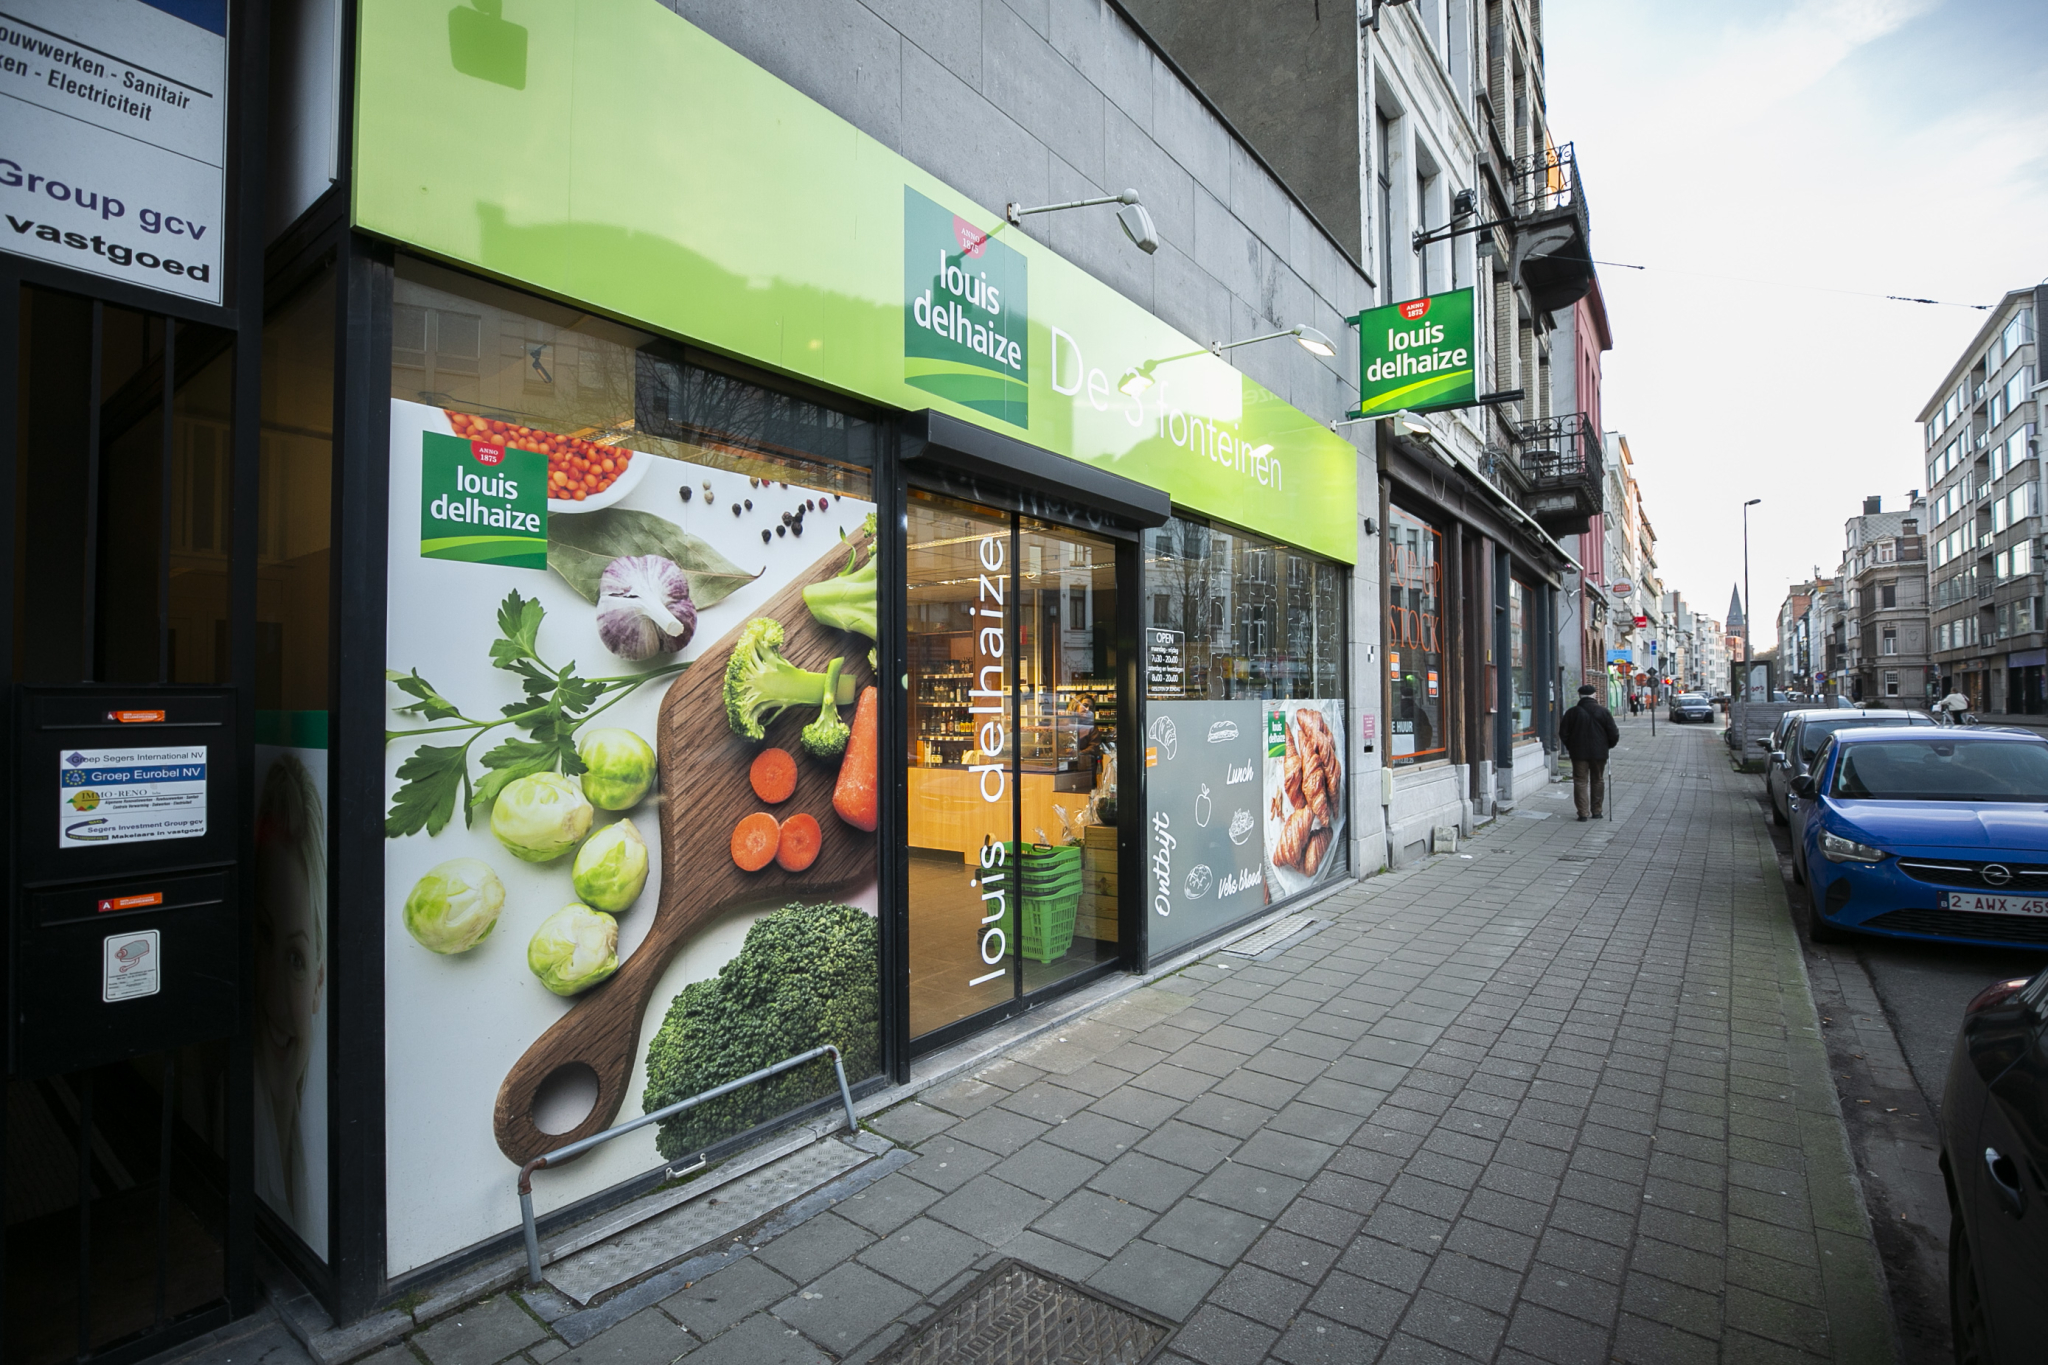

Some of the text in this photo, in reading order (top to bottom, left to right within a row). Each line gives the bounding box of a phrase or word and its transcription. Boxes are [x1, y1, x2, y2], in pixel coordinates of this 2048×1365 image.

[48, 68, 152, 121] Electriciteit
[122, 70, 190, 109] Sanitair
[0, 158, 207, 240] Group gcv
[961, 227, 980, 243] ANNO
[5, 214, 210, 283] vastgoed
[962, 237, 979, 254] 1875
[940, 249, 1000, 315] louis
[1406, 302, 1425, 311] ANNO
[1407, 309, 1424, 318] 1875
[913, 289, 1022, 370] delhaize
[1388, 321, 1445, 352] louis
[1366, 347, 1468, 382] delhaize
[1051, 325, 1109, 411] De
[1156, 380, 1283, 491] fonteinen
[479, 447, 499, 455] ANNO
[480, 454, 498, 463] 1875
[457, 465, 518, 500] louis
[430, 493, 541, 532] delhaize
[1156, 632, 1174, 644] OPEN
[1151, 654, 1163, 663] 7u30
[1165, 656, 1178, 664] 20u00
[1151, 674, 1163, 682] 8u00
[1165, 674, 1179, 683] 20u00
[1396, 721, 1414, 733] HUUR
[71, 755, 100, 764] Groep
[103, 754, 134, 763] Segers
[137, 752, 189, 761] International
[968, 535, 1006, 987] louis delhaize
[91, 767, 201, 781] Groep Eurobel NV
[1226, 758, 1254, 785] Lunch
[87, 826, 117, 834] Segers
[118, 822, 163, 831] Investment
[164, 820, 188, 829] Group
[111, 831, 155, 840] Makelaars
[167, 826, 205, 836] vastgoed
[1152, 811, 1177, 917] Ontbijt
[1940, 900, 1948, 908] B
